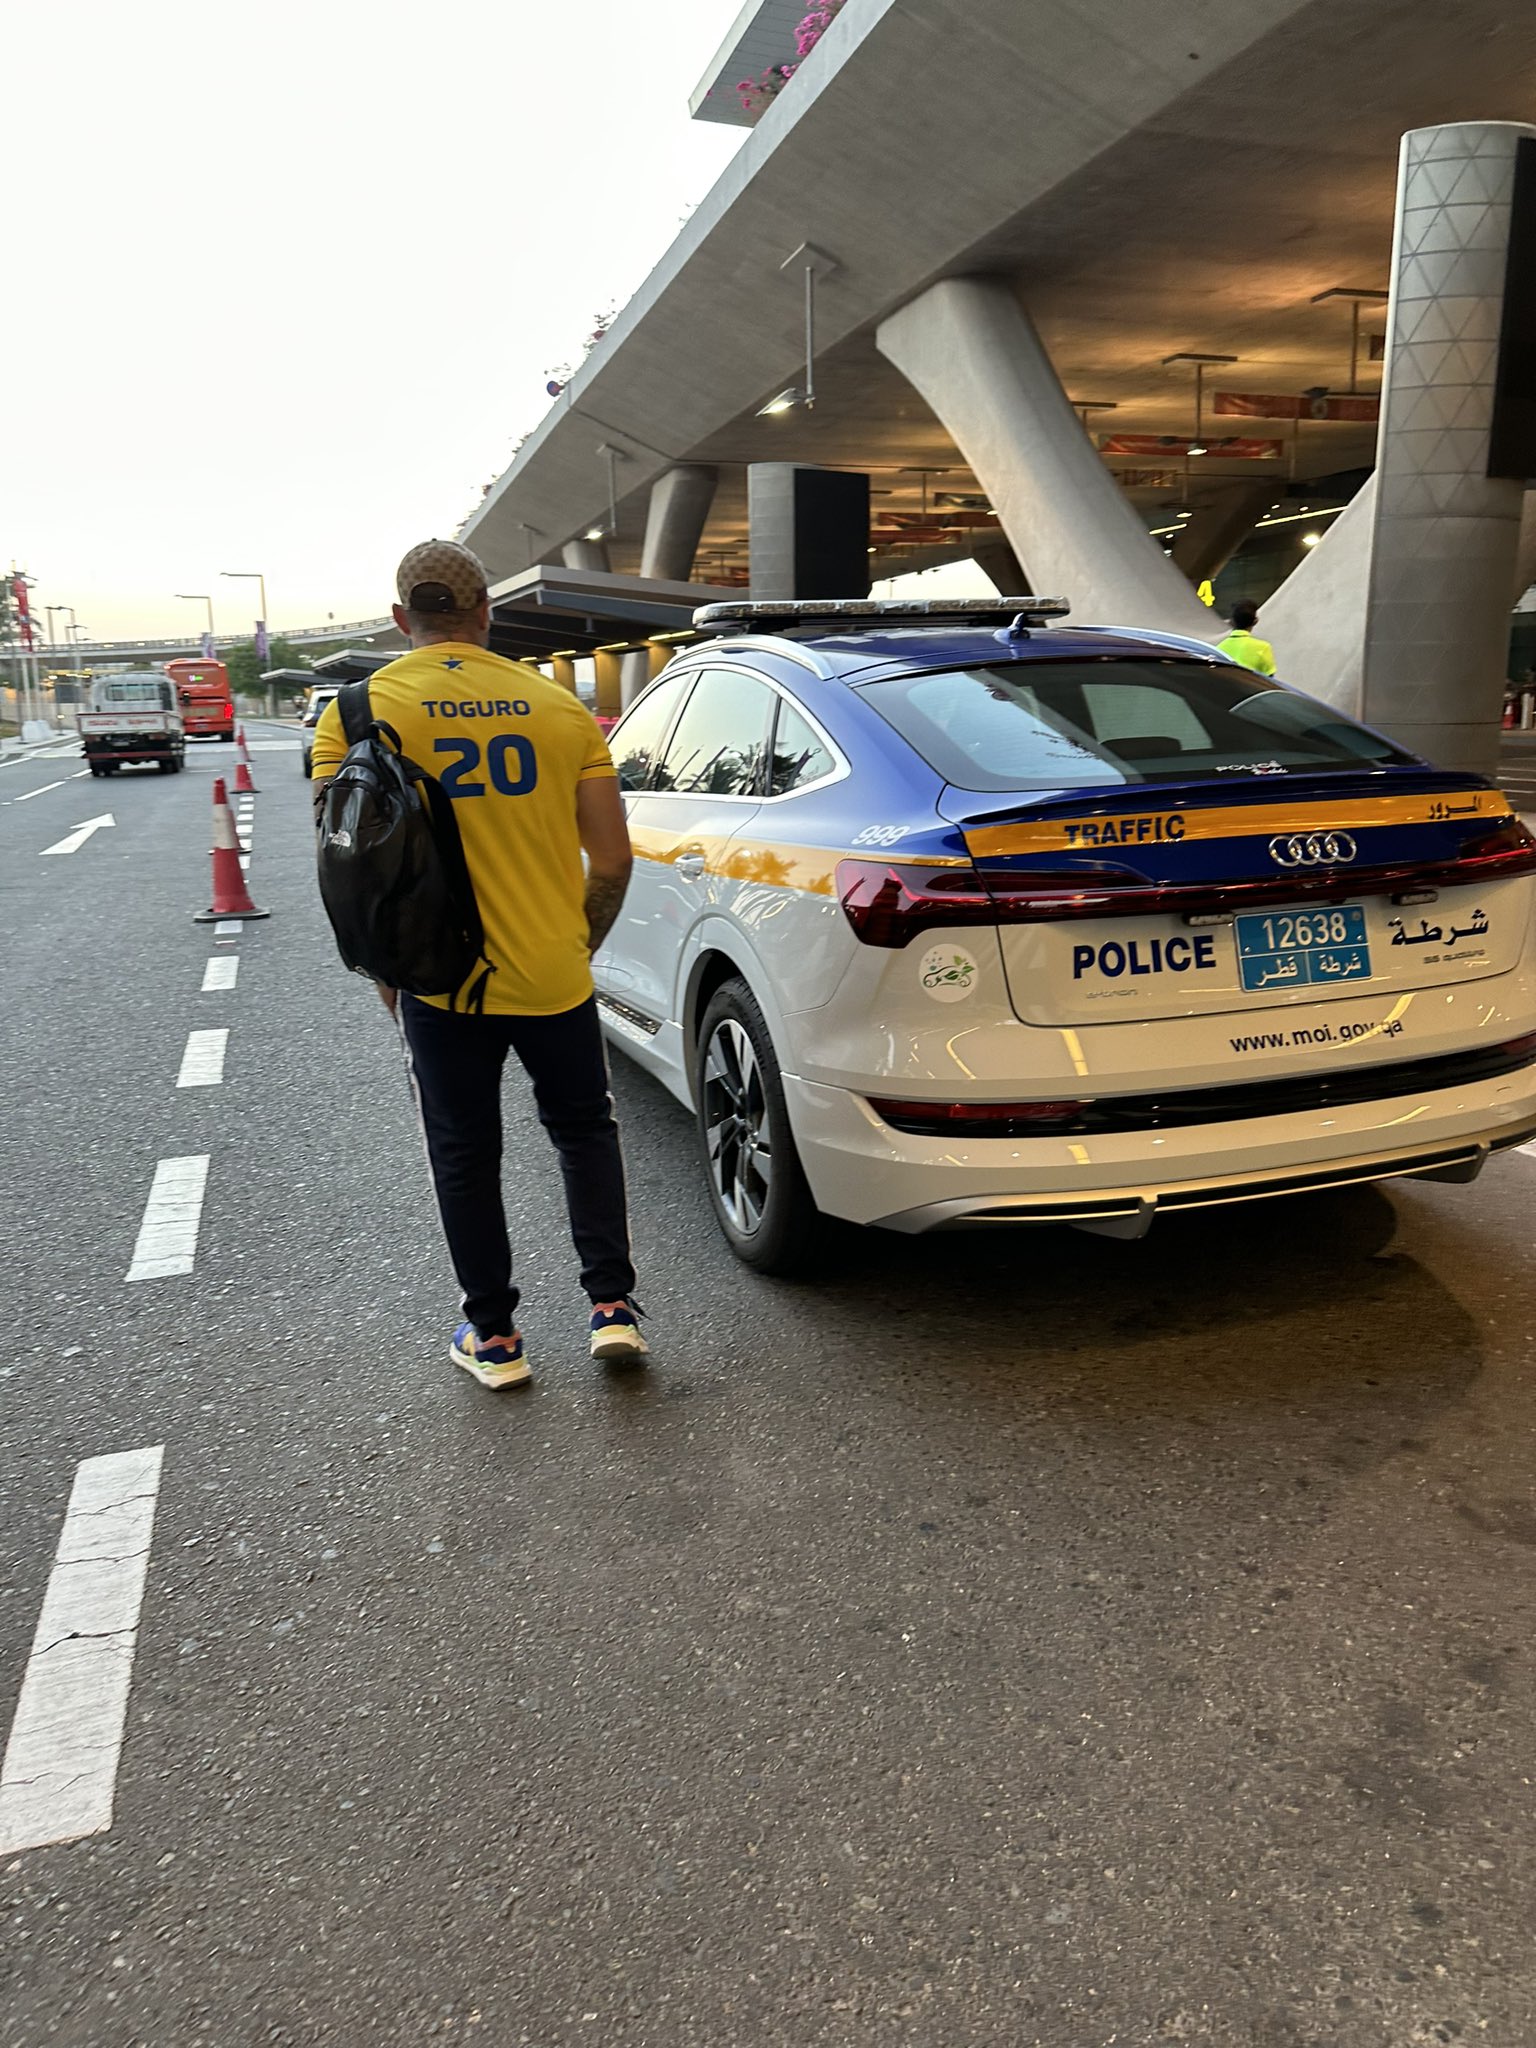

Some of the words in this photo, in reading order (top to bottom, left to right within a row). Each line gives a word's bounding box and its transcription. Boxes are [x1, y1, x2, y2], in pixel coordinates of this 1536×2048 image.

[421, 699, 531, 718] TOGURO
[433, 733, 537, 799] 20
[851, 824, 911, 847] 999
[1064, 814, 1186, 847] TRAFFIC
[1262, 912, 1347, 950] 12638
[1387, 908, 1490, 946] شرطة
[1073, 934, 1217, 979] POLICE
[1255, 955, 1299, 986] قطر
[1319, 952, 1362, 976] شرطة
[1230, 1018, 1404, 1053] www.moi.govqa
